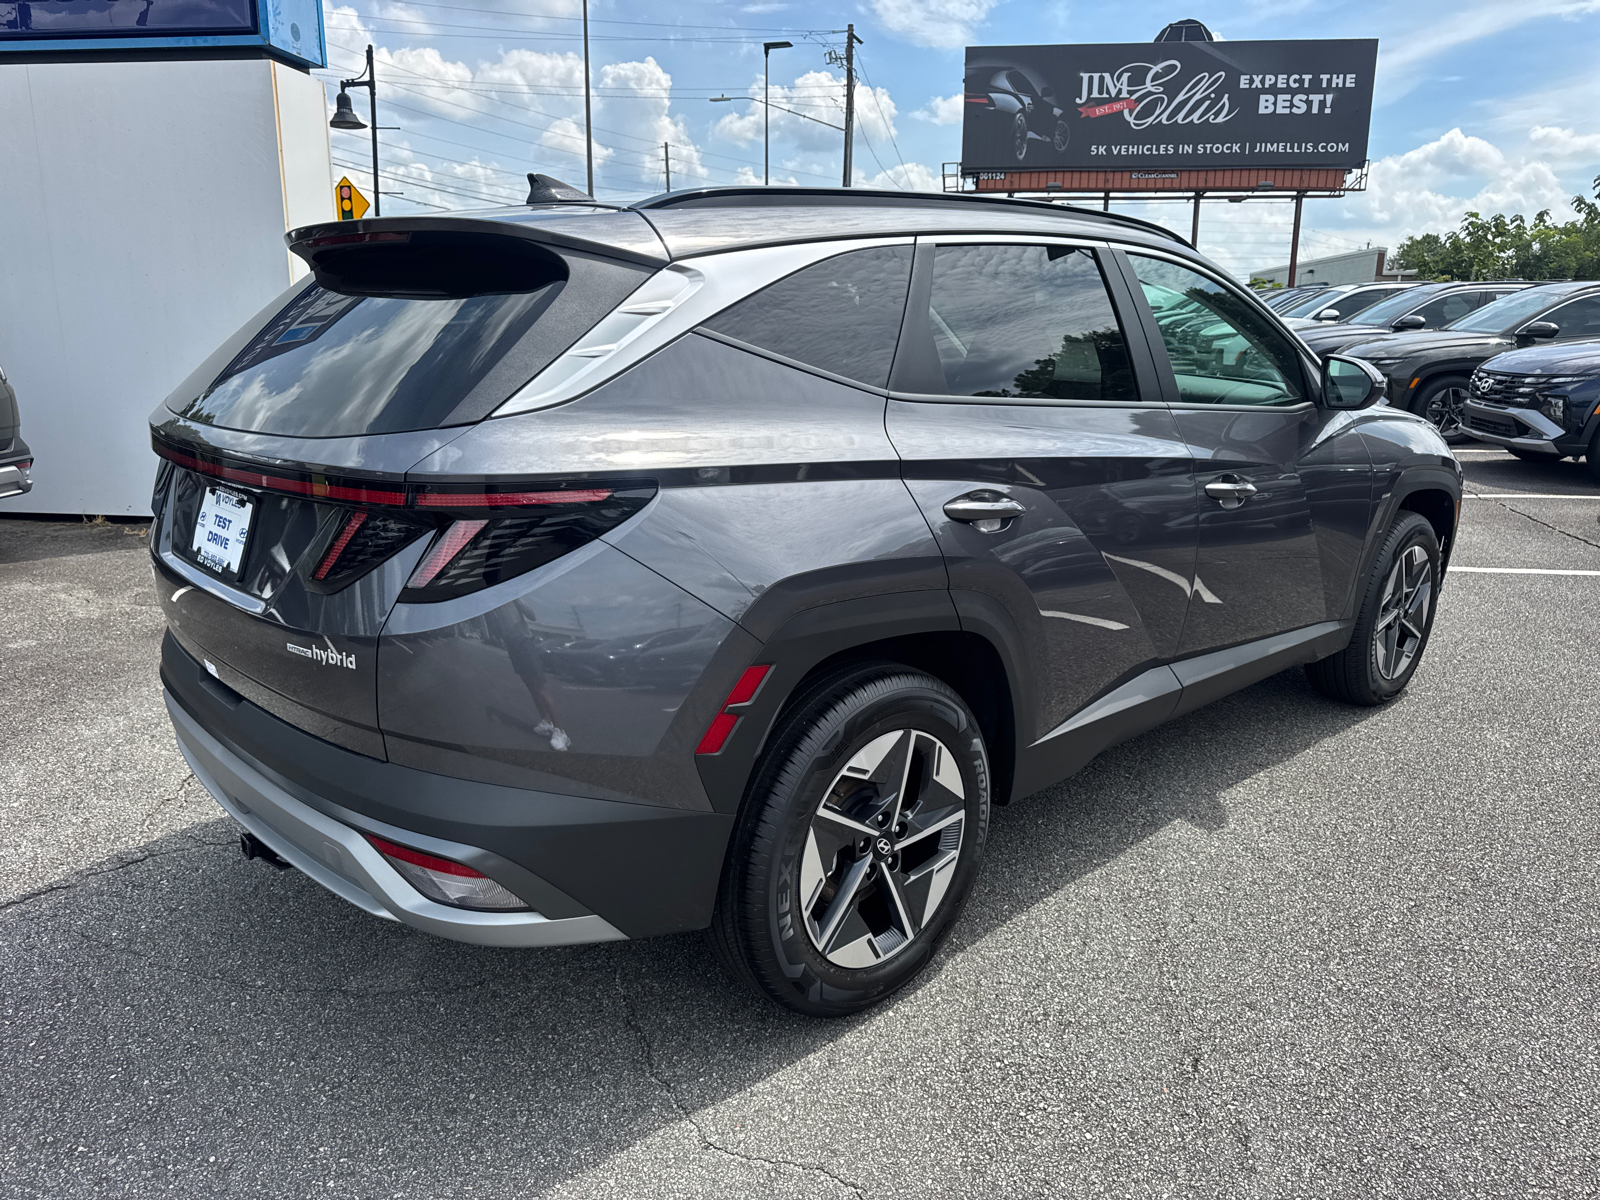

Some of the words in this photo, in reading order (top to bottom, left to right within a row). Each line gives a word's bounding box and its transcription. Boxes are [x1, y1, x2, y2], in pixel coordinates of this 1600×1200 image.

[1239, 74, 1313, 89] EXPECT
[1320, 73, 1357, 88] THE
[1075, 72, 1131, 104] JIM
[1113, 59, 1240, 130] Ellis
[1095, 104, 1112, 116] EST.
[1113, 101, 1128, 112] 1971
[1258, 93, 1334, 115] BEST!
[1090, 145, 1107, 155] 5K
[1111, 144, 1175, 155] VEHICLES
[1178, 144, 1193, 154] IN
[1197, 143, 1241, 154] STOCK
[1254, 142, 1350, 153] JIMELLIS.COM
[213, 513, 233, 531] TEST
[206, 530, 230, 550] DRIVE
[204, 556, 223, 573] VOYLES
[312, 644, 356, 670] hybrid
